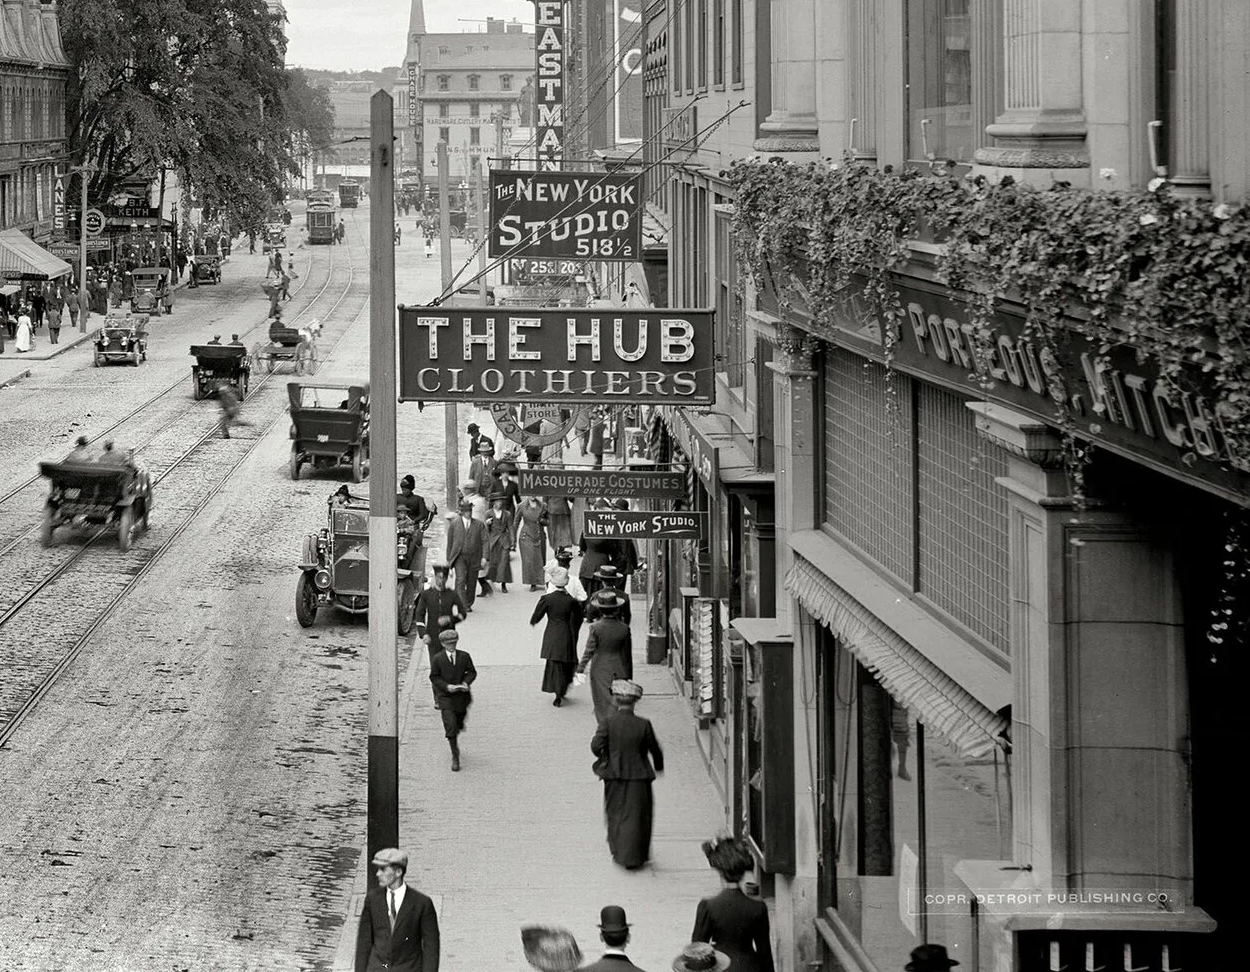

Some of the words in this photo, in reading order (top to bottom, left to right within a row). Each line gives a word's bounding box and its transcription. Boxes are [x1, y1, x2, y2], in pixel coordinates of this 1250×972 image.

[537, 1, 563, 172] EASTMAN
[495, 184, 516, 201] THE
[516, 178, 570, 202] NEW
[573, 179, 636, 205] YORK
[118, 208, 150, 217] KEITH
[498, 209, 630, 246] STUDIO
[417, 316, 542, 362] THE
[566, 317, 696, 363] HUB
[417, 367, 698, 396] CLOTHIERS
[526, 410, 557, 419] STORE
[522, 472, 606, 490] MASQUERADE
[588, 519, 615, 536] NEW
[617, 520, 648, 534] YORK
[652, 515, 698, 534] STUDIO.
